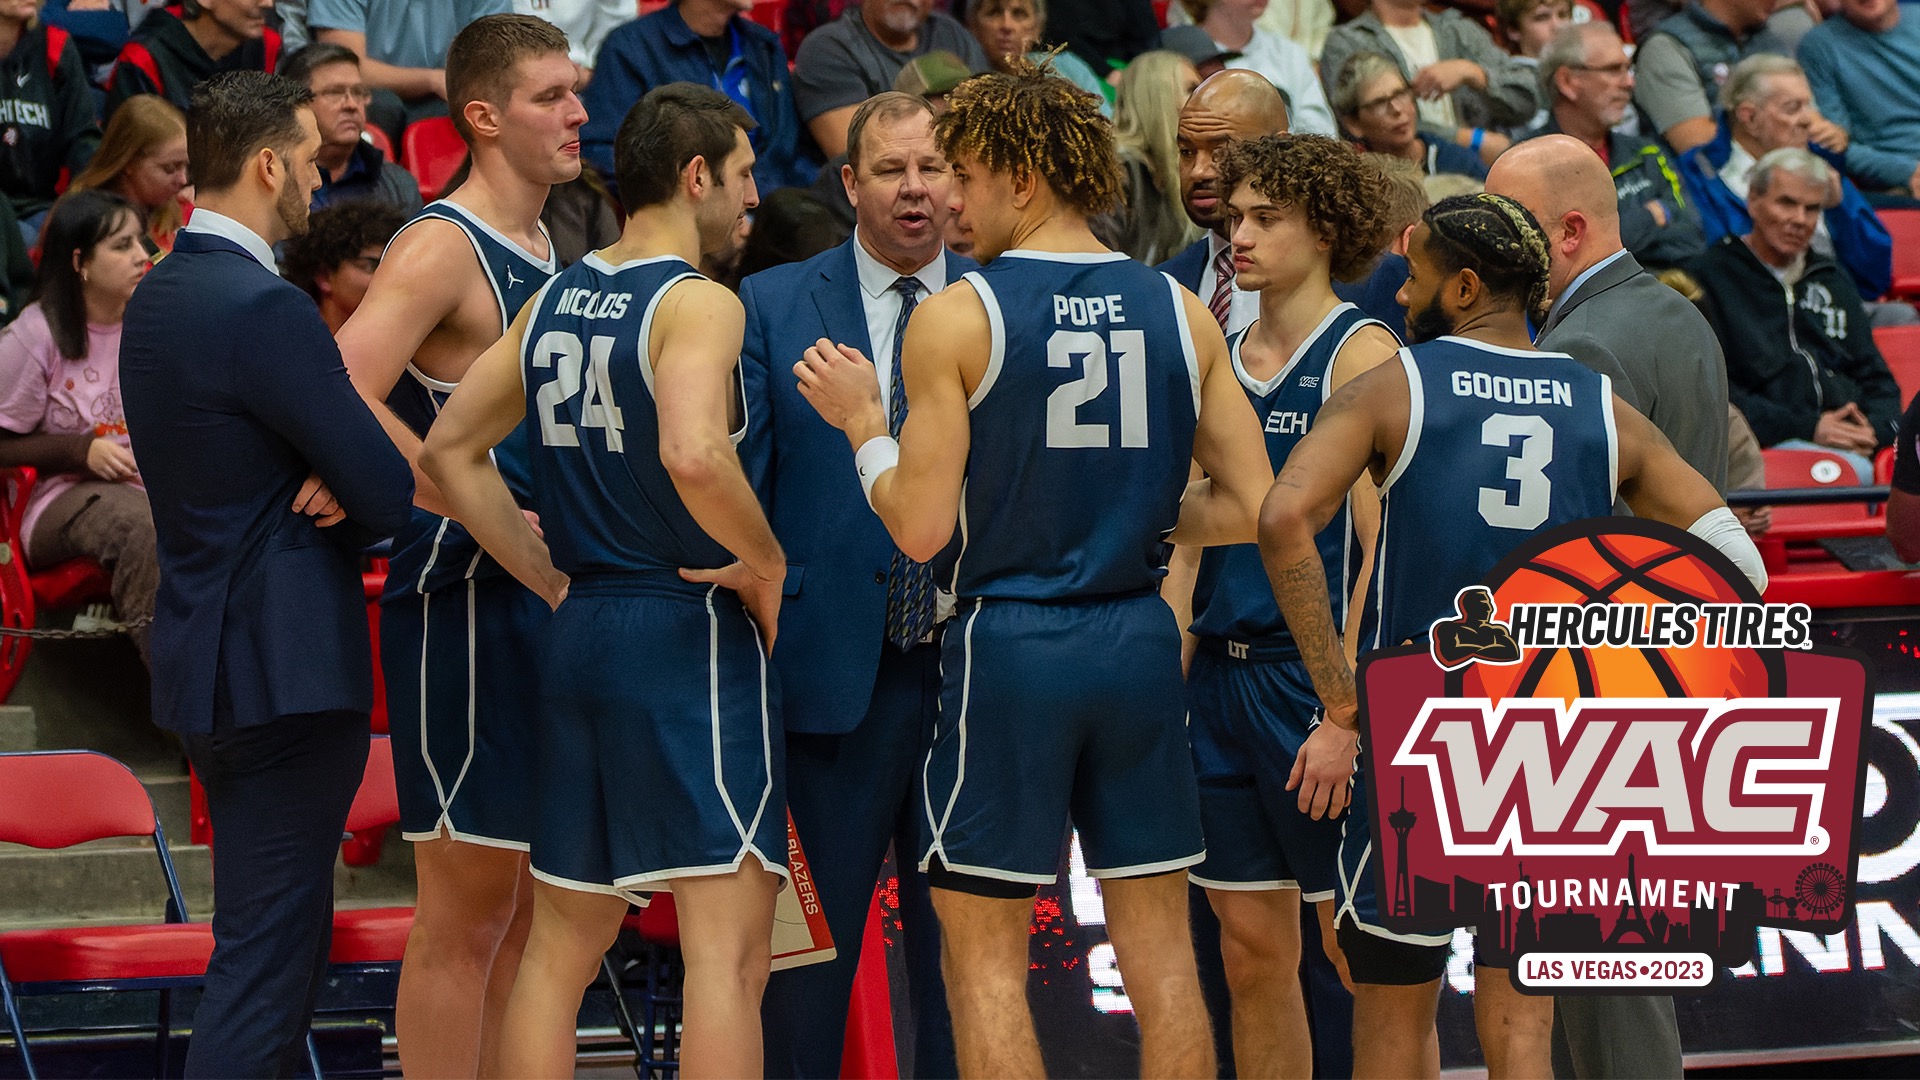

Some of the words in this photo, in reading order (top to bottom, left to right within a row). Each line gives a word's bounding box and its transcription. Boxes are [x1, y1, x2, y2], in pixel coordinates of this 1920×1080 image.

[554, 287, 633, 320] NICODS
[1053, 294, 1126, 326] POPE
[532, 330, 625, 454] 24
[1046, 329, 1149, 449] 21
[1451, 371, 1573, 408] GOODEN
[1264, 410, 1309, 435] ECH
[1478, 412, 1554, 531] 3
[787, 824, 820, 915] BLAZERS
